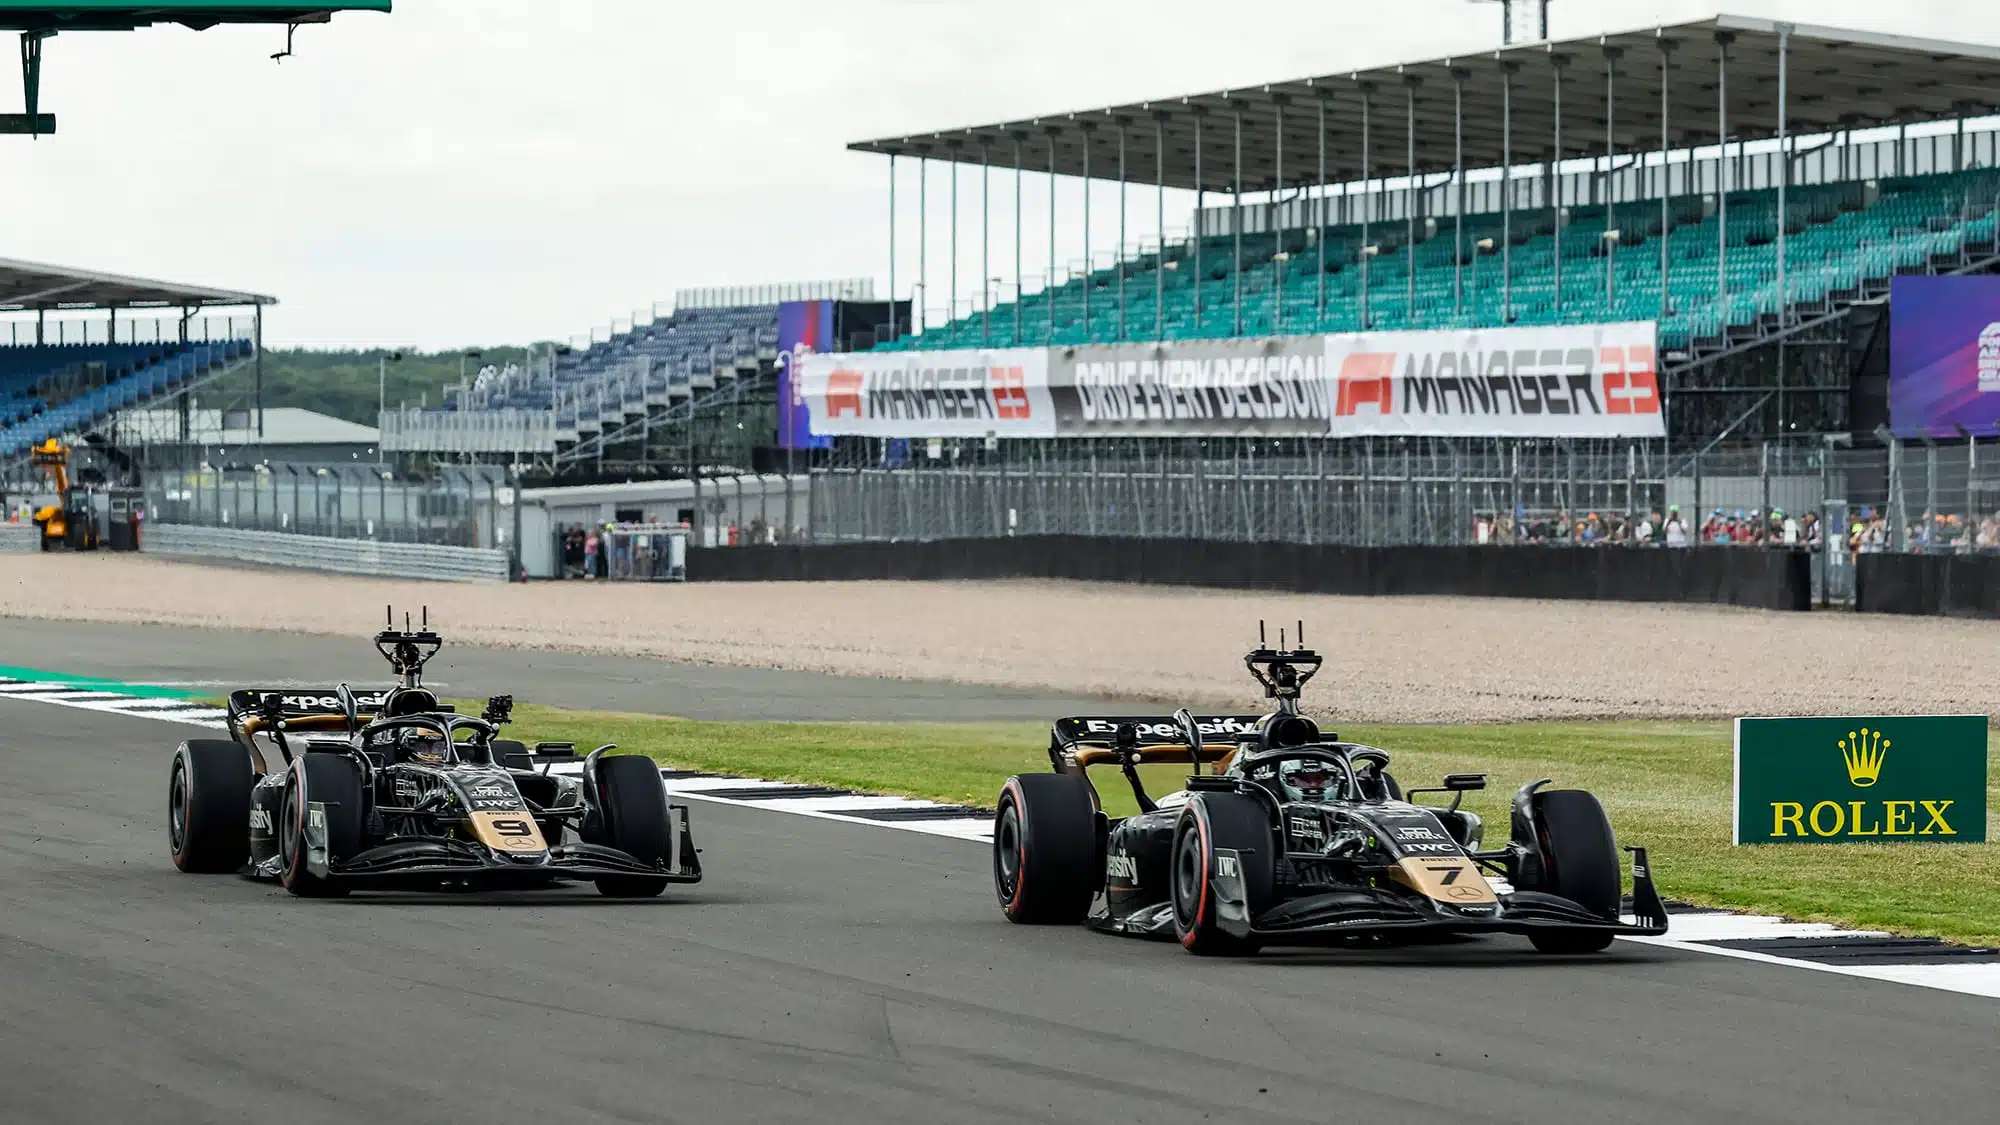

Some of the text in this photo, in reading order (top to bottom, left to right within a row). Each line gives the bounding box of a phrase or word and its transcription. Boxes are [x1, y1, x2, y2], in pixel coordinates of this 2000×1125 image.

[868, 367, 995, 420] MANAGER
[989, 367, 1031, 420] 23
[1076, 355, 1329, 420] DRIVE EVERY DECISION
[1402, 348, 1601, 415] MANAGER
[1599, 344, 1661, 414] 23
[492, 820, 532, 836] 9
[1770, 800, 1958, 837] ROLEX
[1403, 843, 1456, 852] IWC
[1217, 856, 1237, 877] IWC
[1426, 866, 1464, 885] 7
